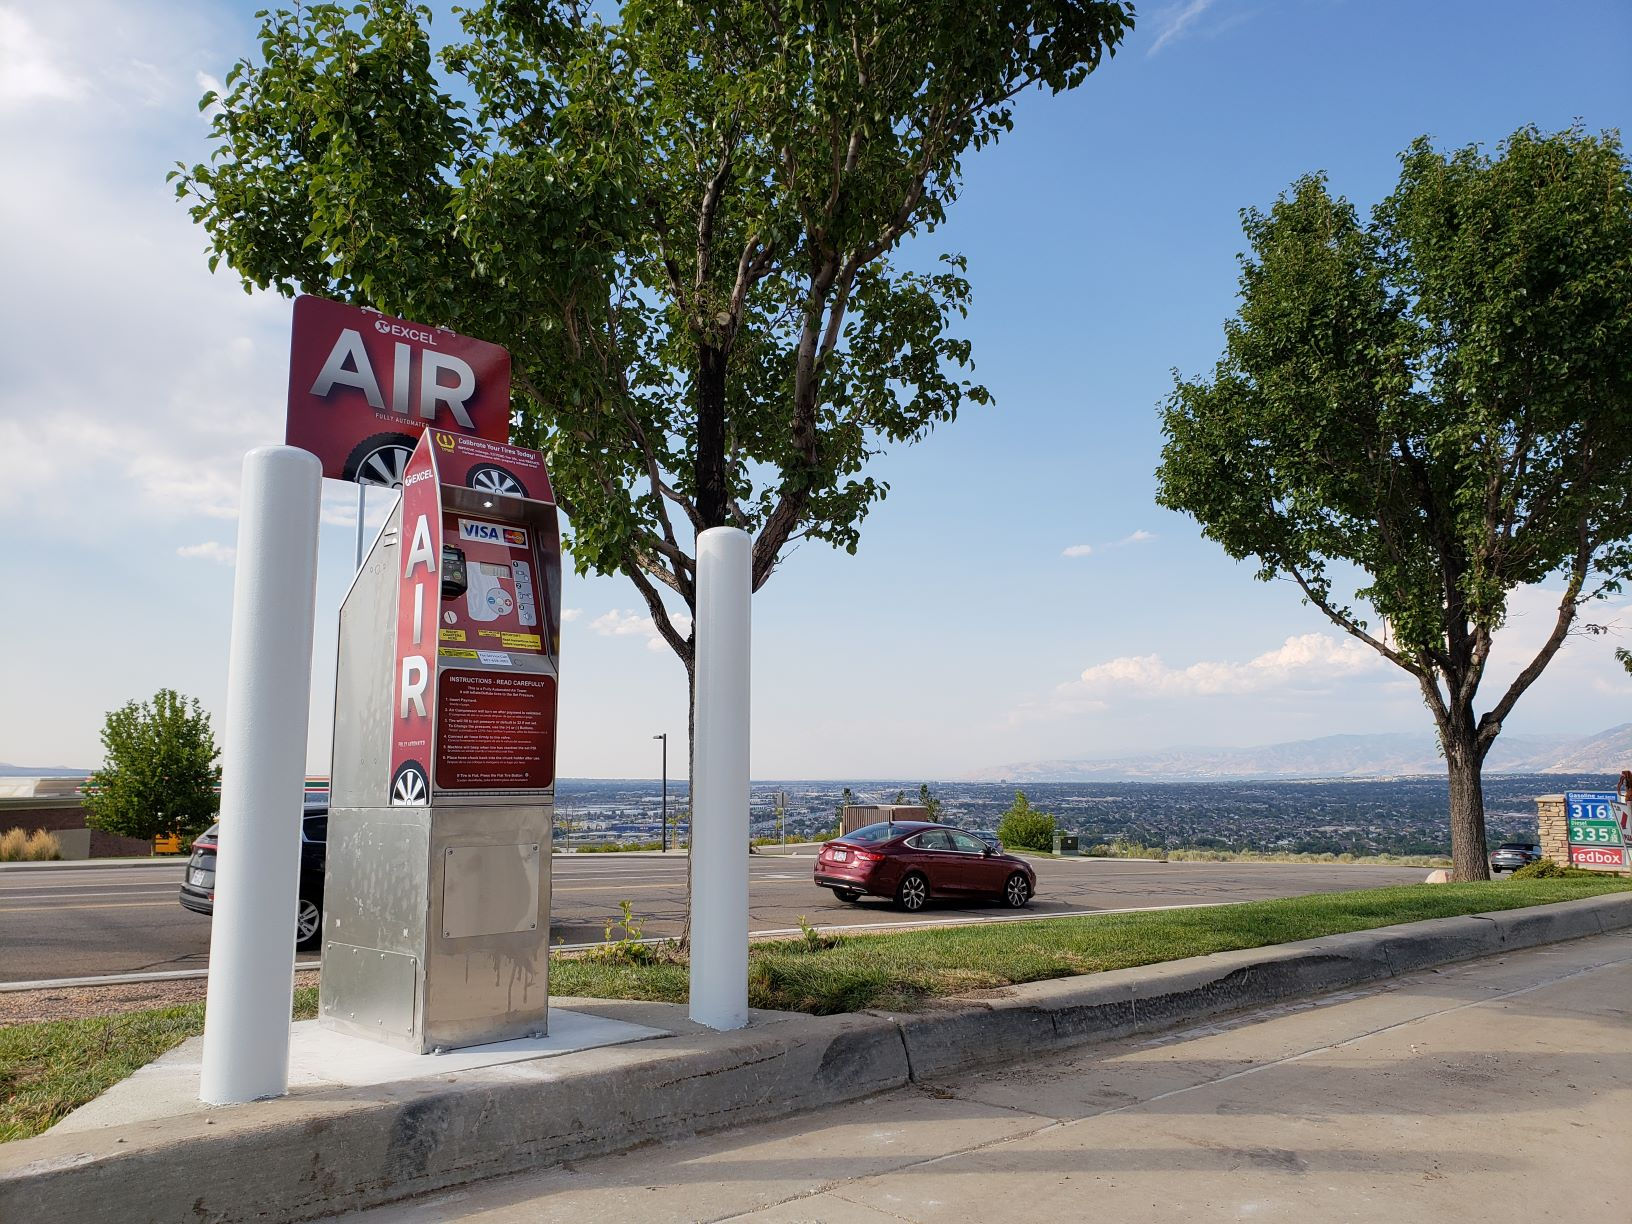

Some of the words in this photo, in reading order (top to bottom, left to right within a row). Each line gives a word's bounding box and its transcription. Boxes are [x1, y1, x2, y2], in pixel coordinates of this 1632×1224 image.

[392, 325, 437, 346] EXCEL
[309, 328, 476, 429] AIR
[375, 412, 394, 421] FULLY
[395, 417, 430, 428] AUTOMATED
[458, 437, 486, 449] Calibrate
[486, 443, 500, 452] Your
[500, 446, 516, 455] Tires
[516, 449, 536, 460] Today!
[412, 469, 433, 484] EXCEL
[463, 523, 499, 541] VISA
[400, 514, 436, 719] AIR
[450, 676, 492, 684] INSTRUCTIONS
[1571, 804, 1607, 819] 316
[1573, 827, 1609, 842] 335
[1572, 851, 1621, 864] redbox
